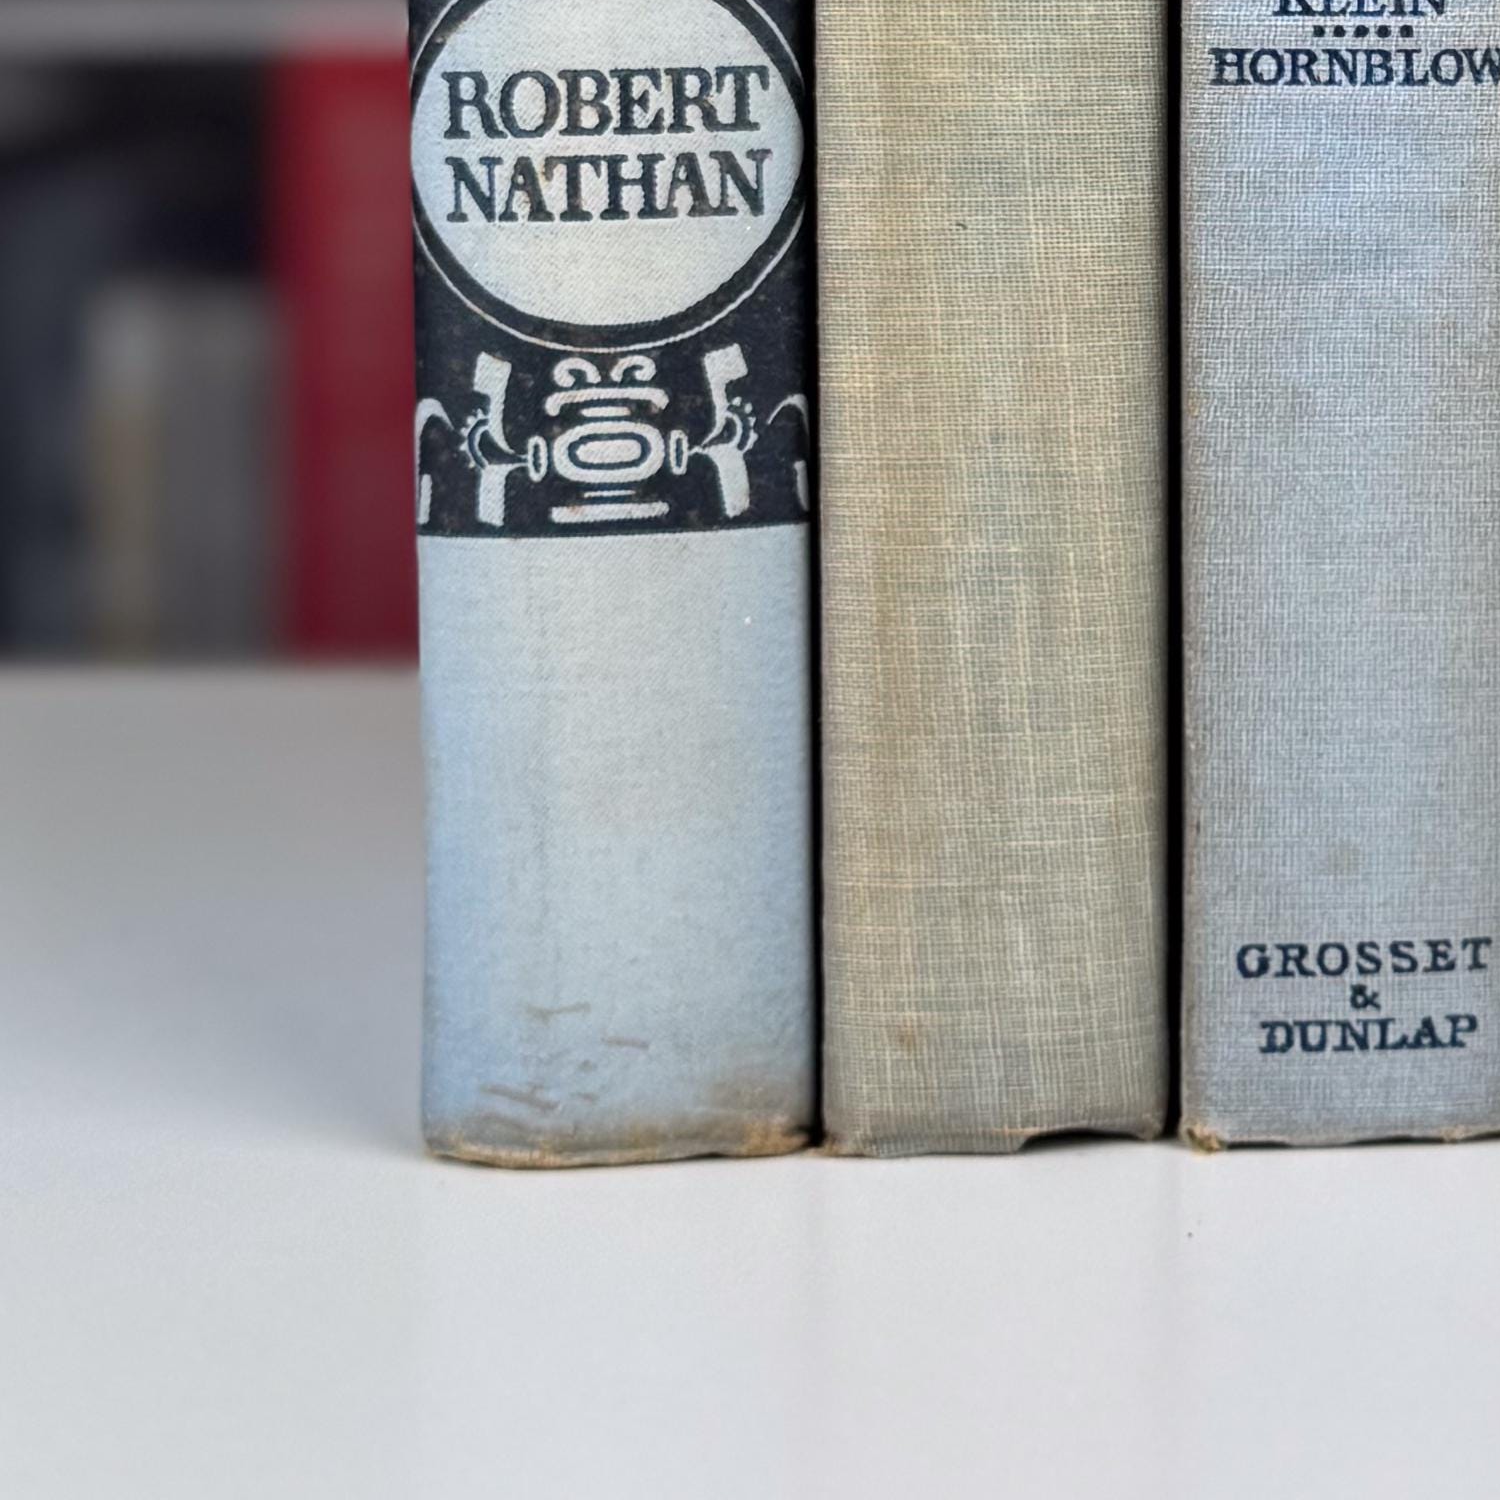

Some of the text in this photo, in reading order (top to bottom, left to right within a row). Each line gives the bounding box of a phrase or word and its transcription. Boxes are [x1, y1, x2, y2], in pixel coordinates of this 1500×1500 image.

[441, 65, 769, 139] ROBERT
[446, 148, 772, 222] NATHAN
[1236, 937, 1492, 978] GROSSET
[1350, 984, 1381, 1010] &
[1259, 1014, 1477, 1053] DUNLAP
